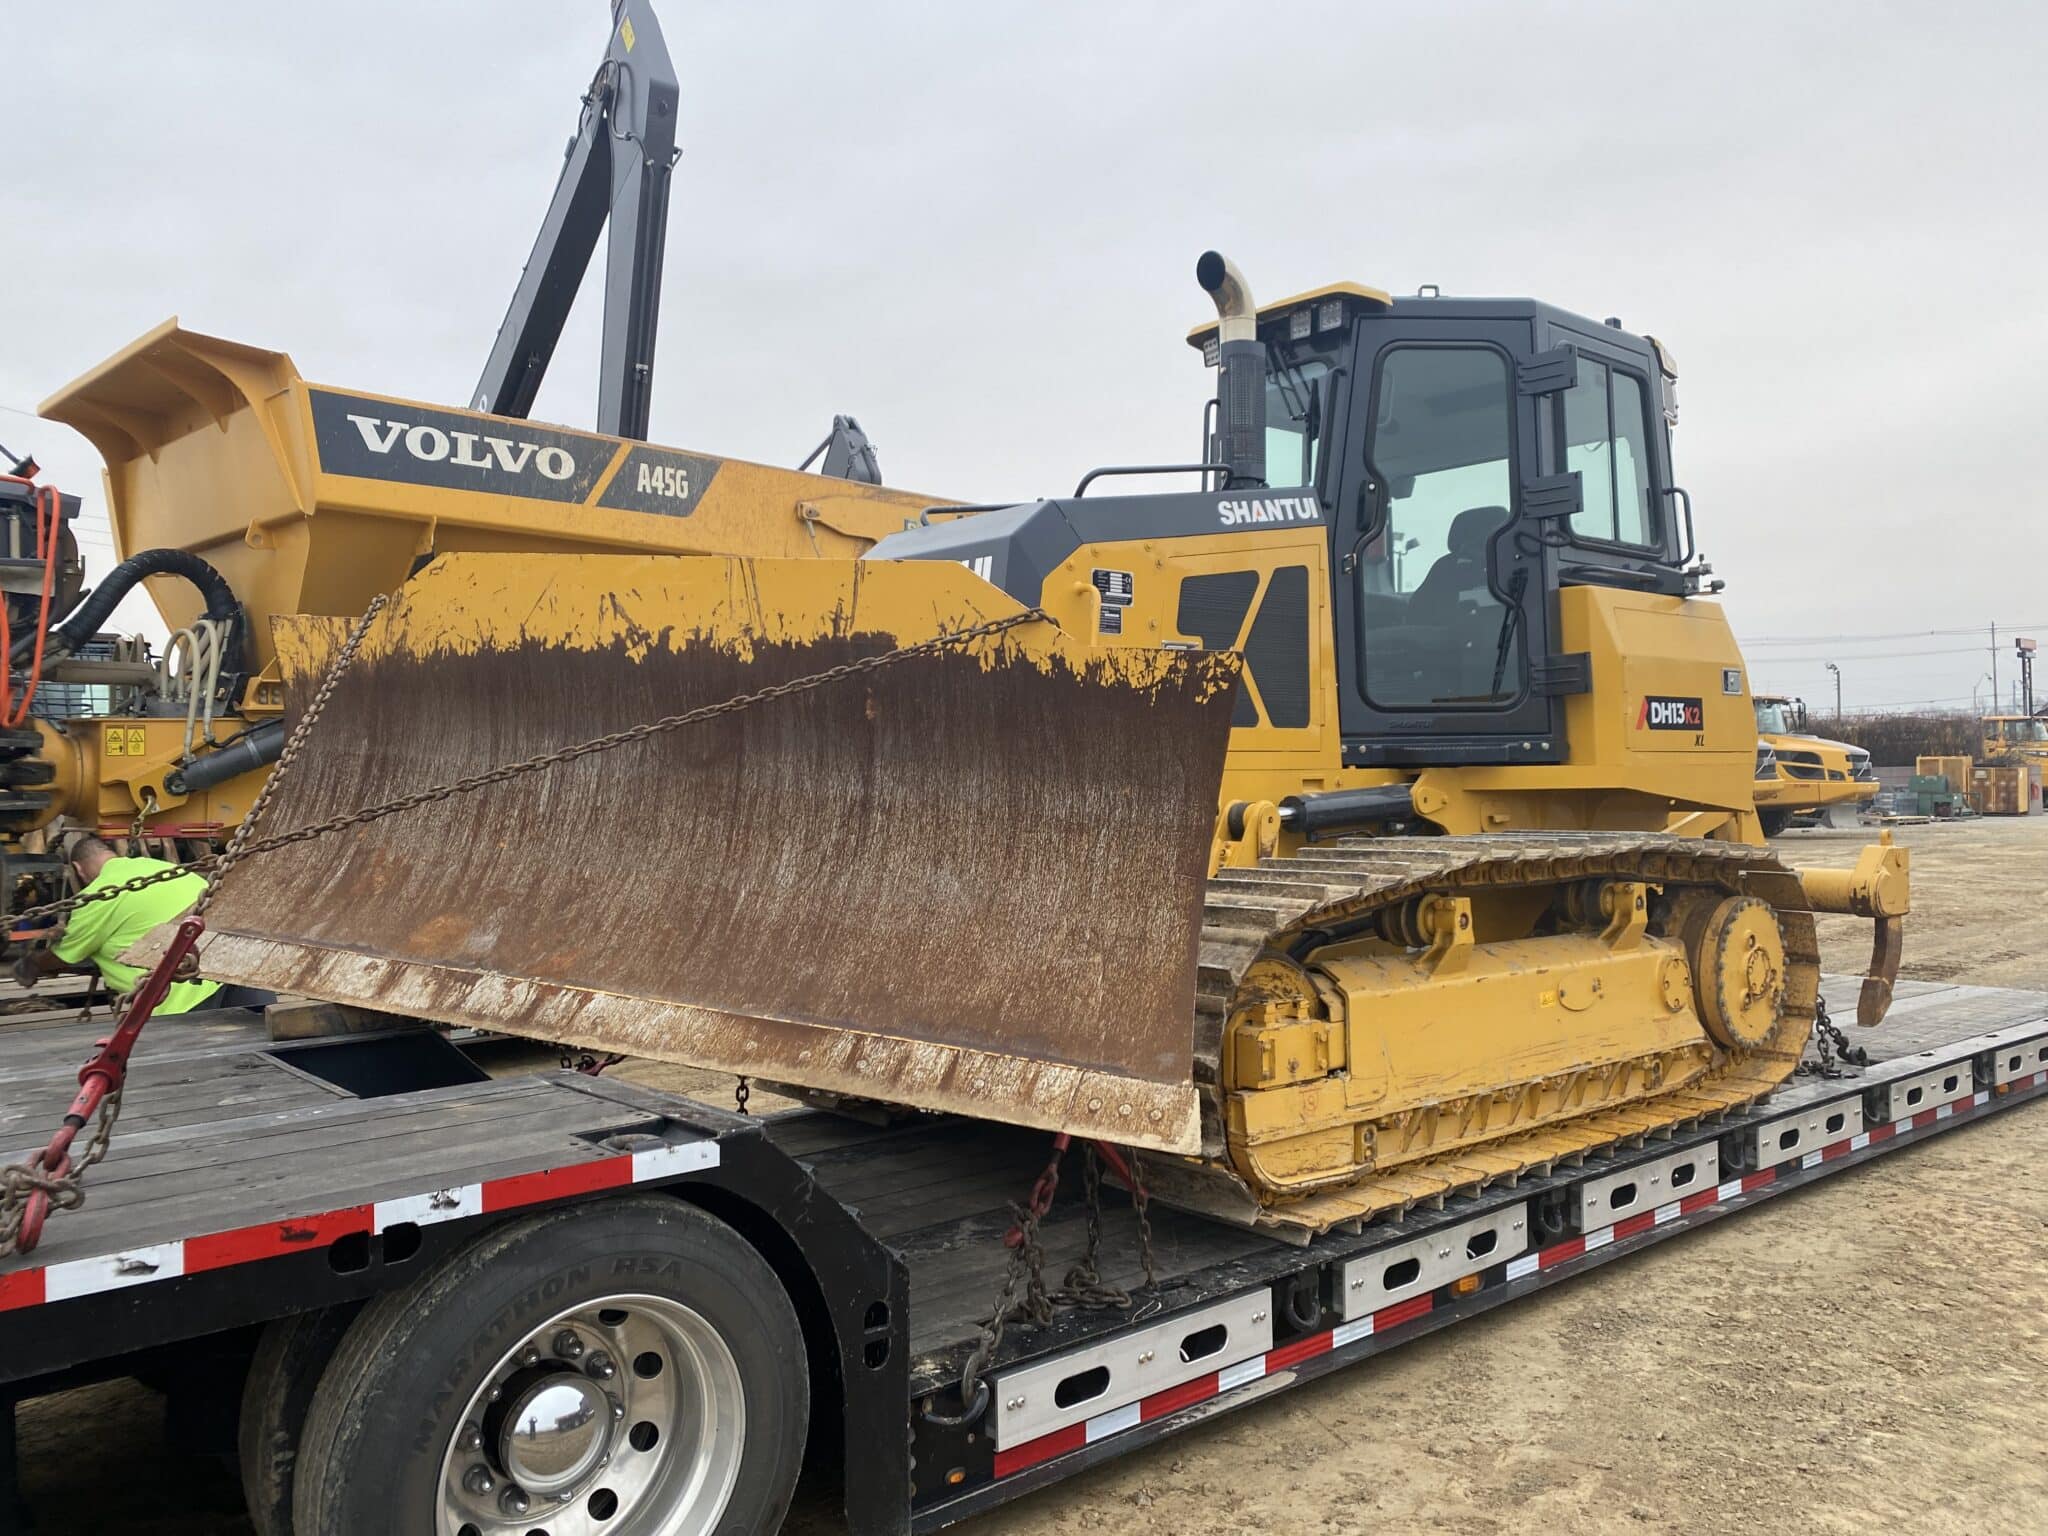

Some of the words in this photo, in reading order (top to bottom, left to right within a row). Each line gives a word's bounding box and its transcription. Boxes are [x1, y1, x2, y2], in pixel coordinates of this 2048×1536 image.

[347, 414, 575, 480] VOLVO
[637, 463, 689, 499] A45G
[1218, 497, 1319, 525] SHANTUI
[1651, 702, 1700, 724] DH13K2
[1694, 734, 1704, 746] XL
[609, 1257, 682, 1280] RSA
